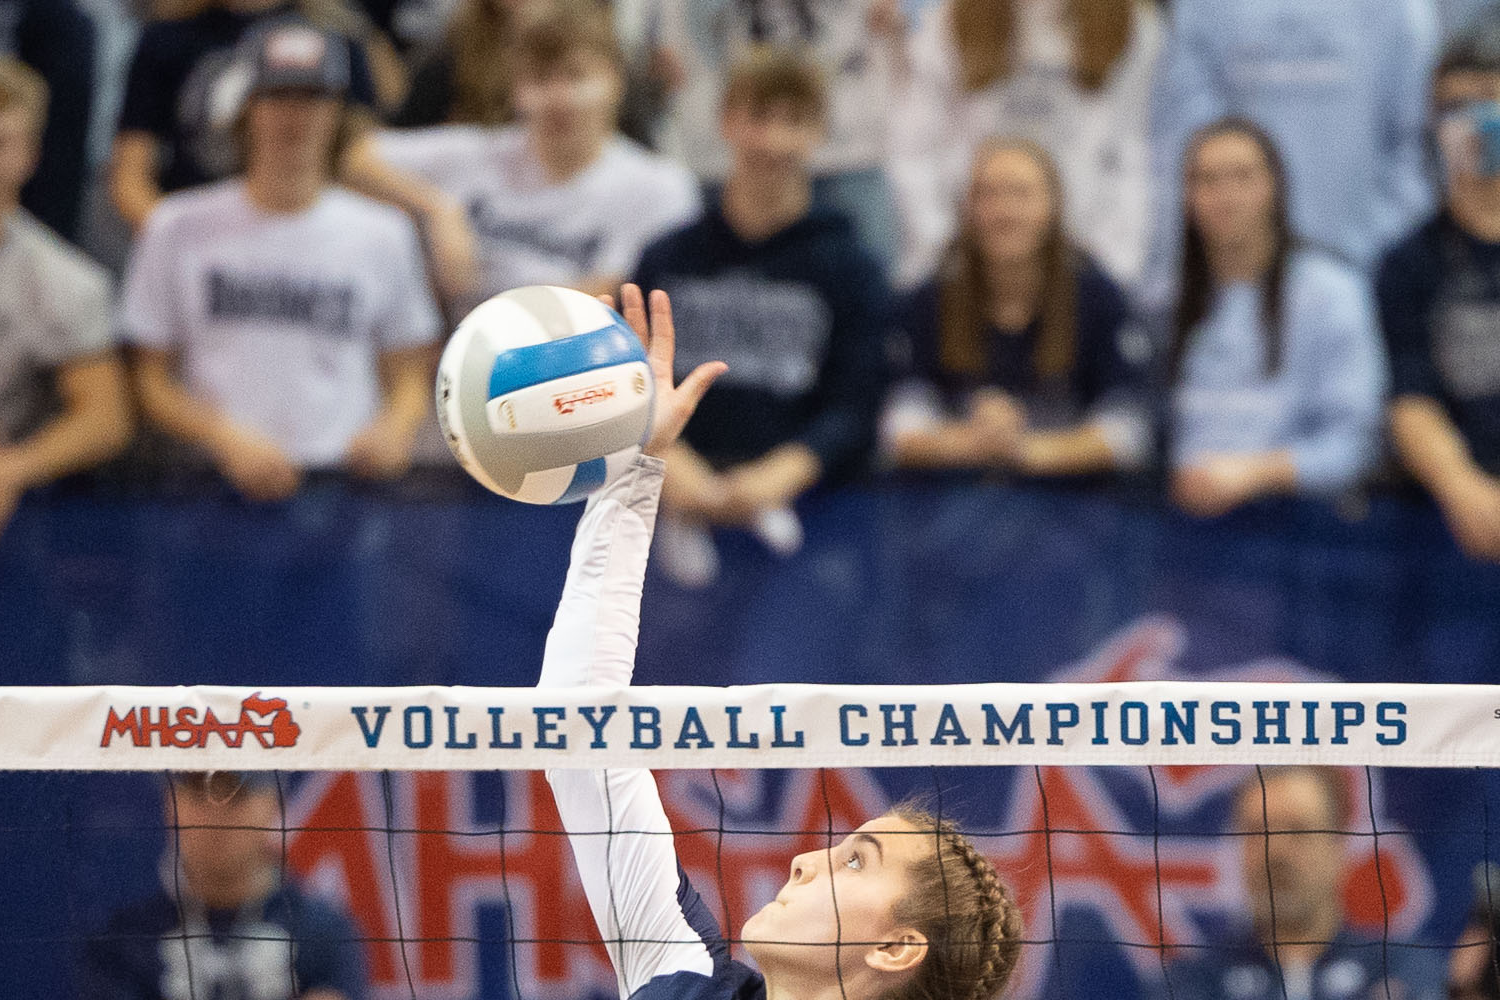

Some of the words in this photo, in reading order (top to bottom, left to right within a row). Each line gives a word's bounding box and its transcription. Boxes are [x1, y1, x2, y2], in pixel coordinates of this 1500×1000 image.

[100, 696, 298, 748] MHSAA
[352, 704, 805, 750] VOLLEYBALL
[838, 700, 1409, 747] CHAMPIONSHIPS
